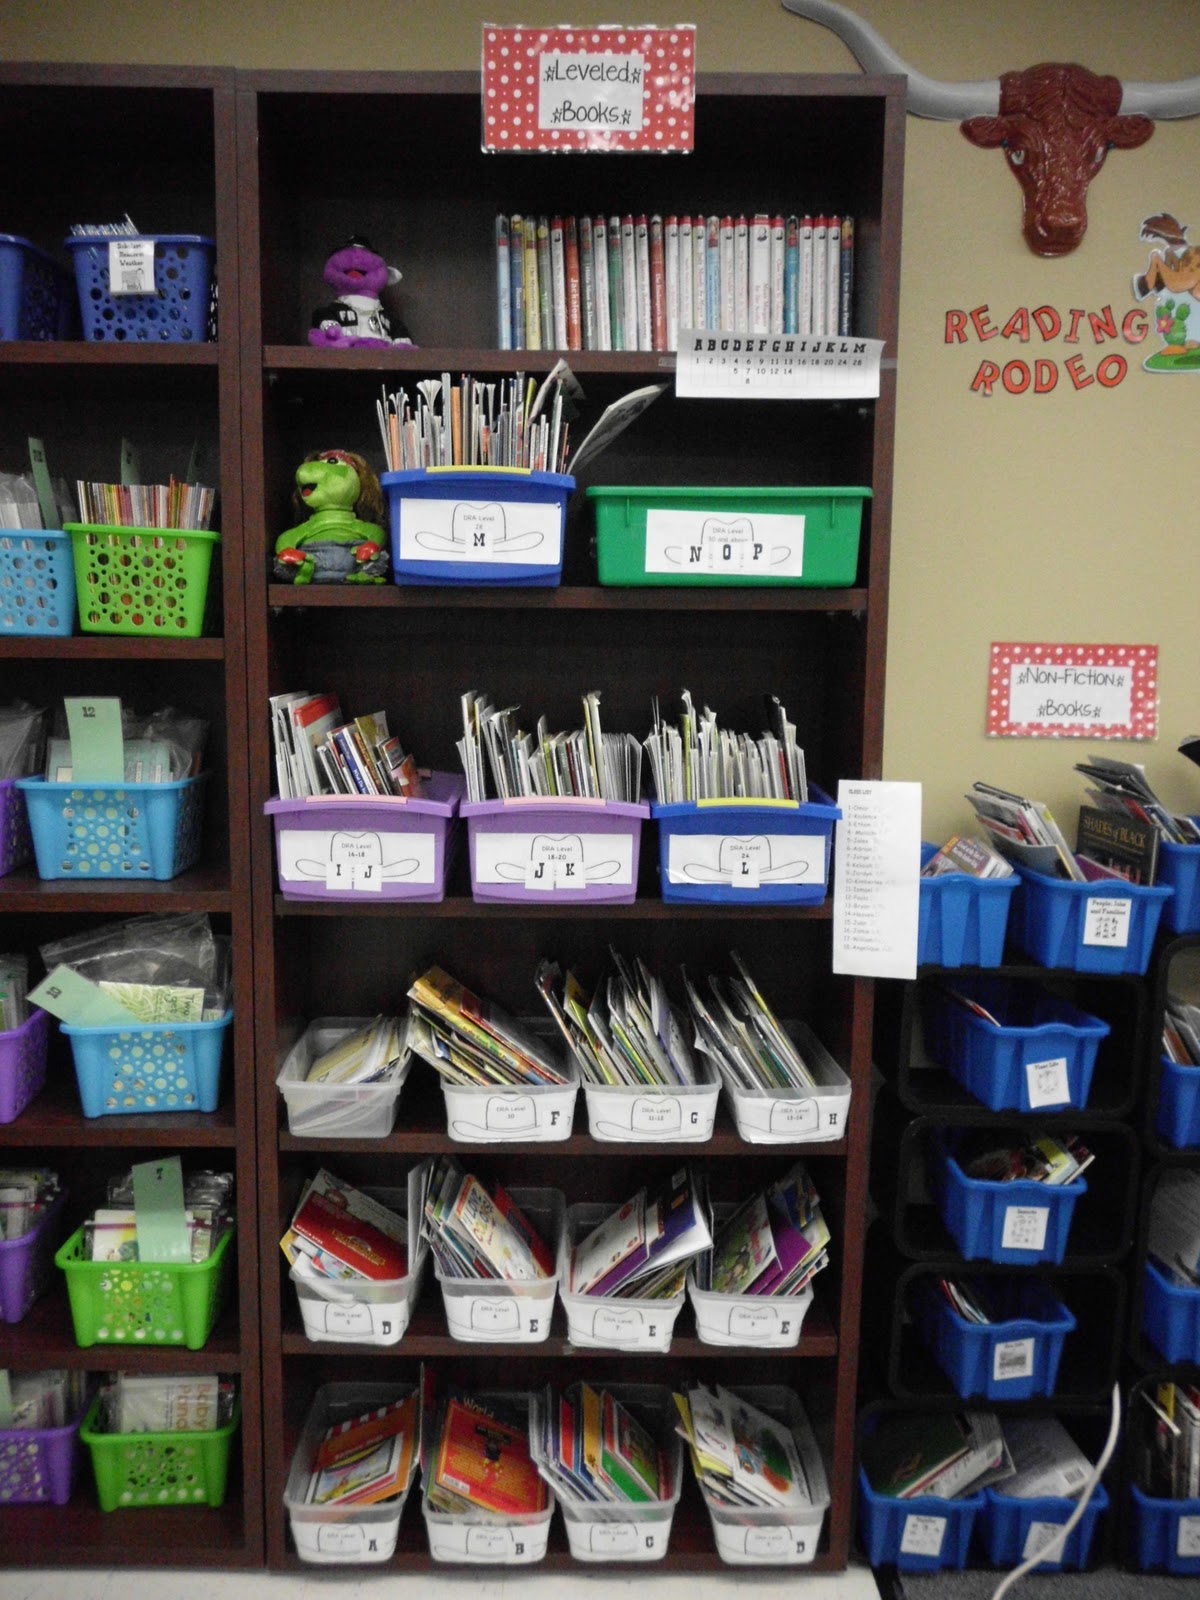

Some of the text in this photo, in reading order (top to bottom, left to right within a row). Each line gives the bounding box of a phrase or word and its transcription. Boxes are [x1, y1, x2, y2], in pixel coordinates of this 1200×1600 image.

[555, 60, 629, 81] Leveled
[562, 100, 619, 123] Books
[843, 278, 850, 291] Am
[944, 304, 1149, 344] READING
[694, 339, 866, 353] A B C D E F G H I J K L M
[970, 353, 1128, 396] RODEO
[473, 533, 485, 547] M
[690, 543, 763, 563] N O P
[1026, 667, 1115, 686] Non-Fiction
[82, 706, 96, 718] 12
[1046, 699, 1092, 717] Books
[1083, 816, 1113, 837] SHADES
[1118, 827, 1146, 848] BLACK
[336, 864, 373, 878] I J
[534, 862, 575, 878] J K
[741, 862, 749, 875] L
[550, 1111, 560, 1126] F
[691, 1111, 699, 1124] G
[829, 1113, 837, 1125] H
[382, 1320, 392, 1335] D
[529, 1319, 539, 1333] E
[649, 1325, 656, 1337] E
[780, 1321, 791, 1335] E
[368, 1539, 378, 1551] A
[515, 1543, 525, 1555] B
[645, 1536, 654, 1548] C
